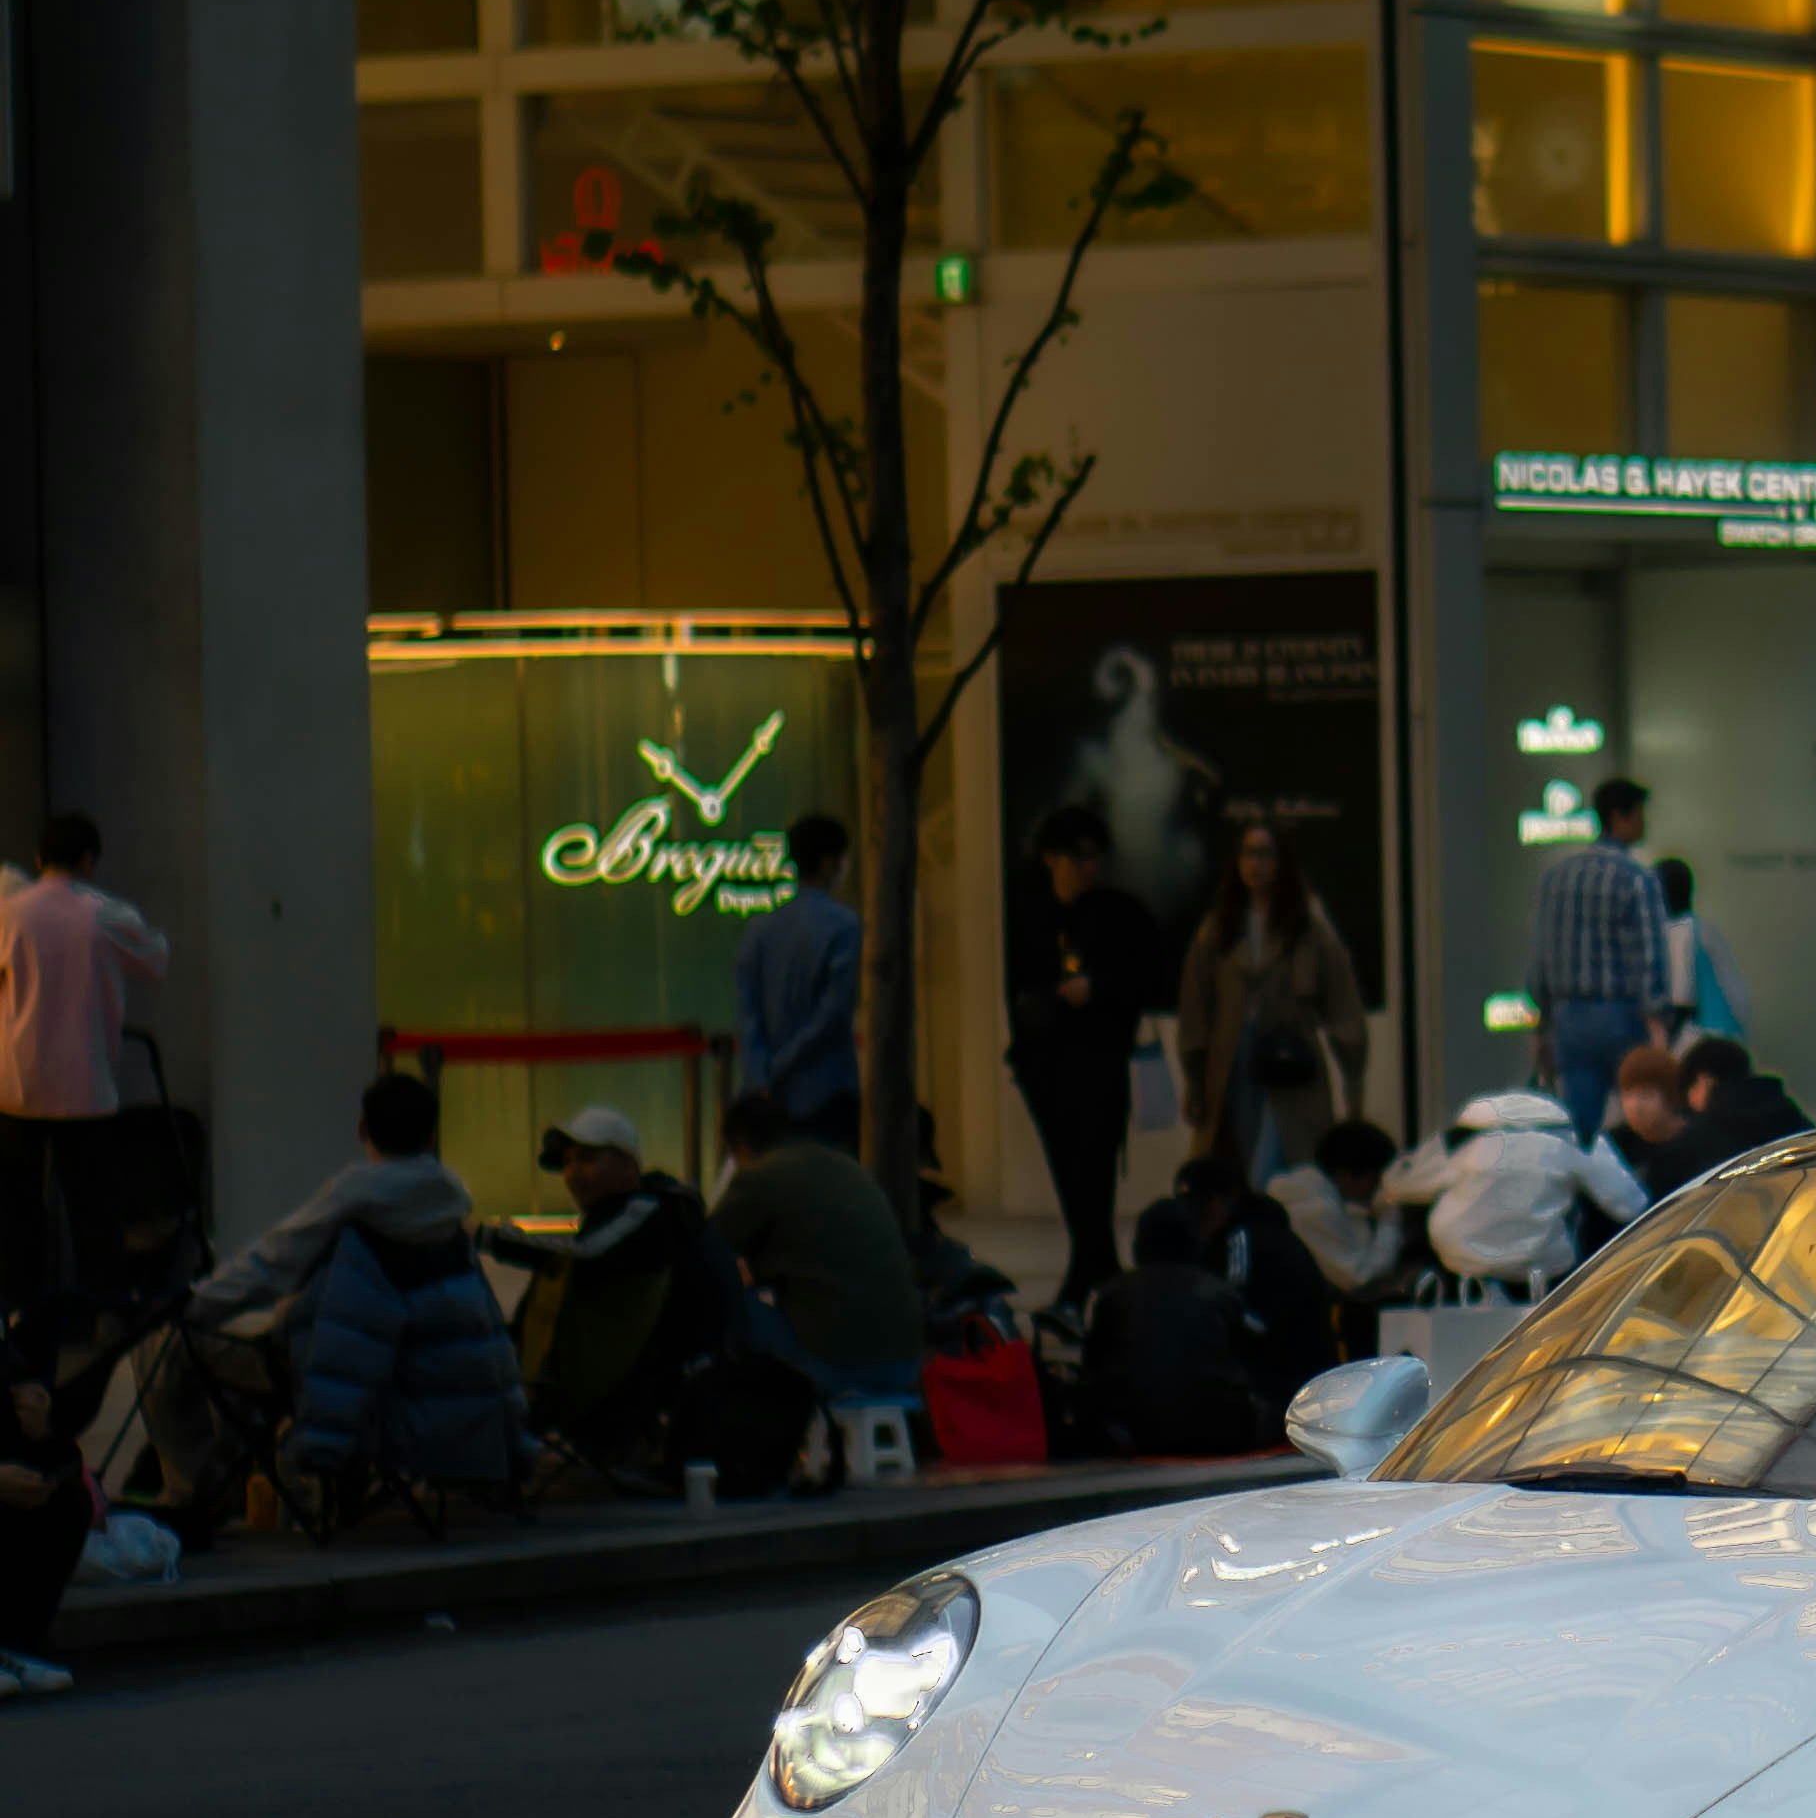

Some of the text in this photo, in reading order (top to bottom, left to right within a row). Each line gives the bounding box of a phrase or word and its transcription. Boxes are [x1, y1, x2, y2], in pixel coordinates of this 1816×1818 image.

[1497, 459, 1619, 494] NICOLAS
[1624, 462, 1650, 495] G.
[1655, 464, 1744, 499] HAYEK
